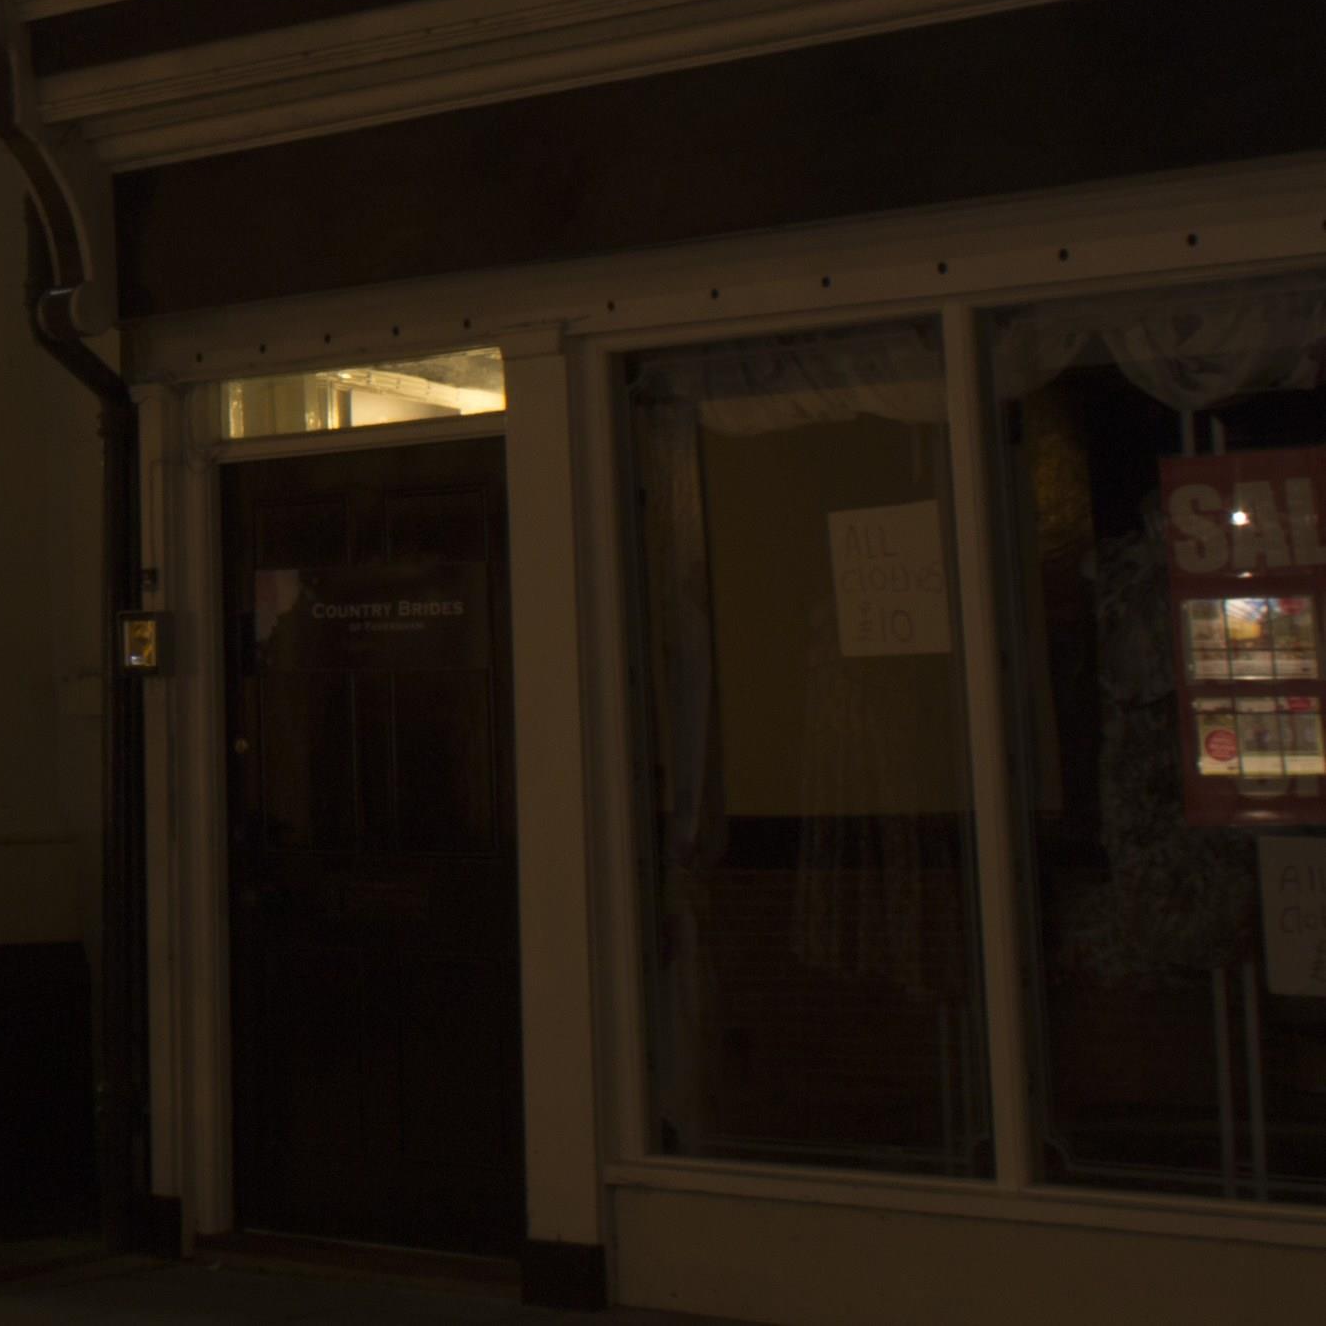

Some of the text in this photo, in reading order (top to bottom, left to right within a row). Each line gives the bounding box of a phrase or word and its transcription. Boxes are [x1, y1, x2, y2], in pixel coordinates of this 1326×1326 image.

[1168, 477, 1326, 575] SAL
[311, 599, 465, 619] COUNTRY BRIDES
